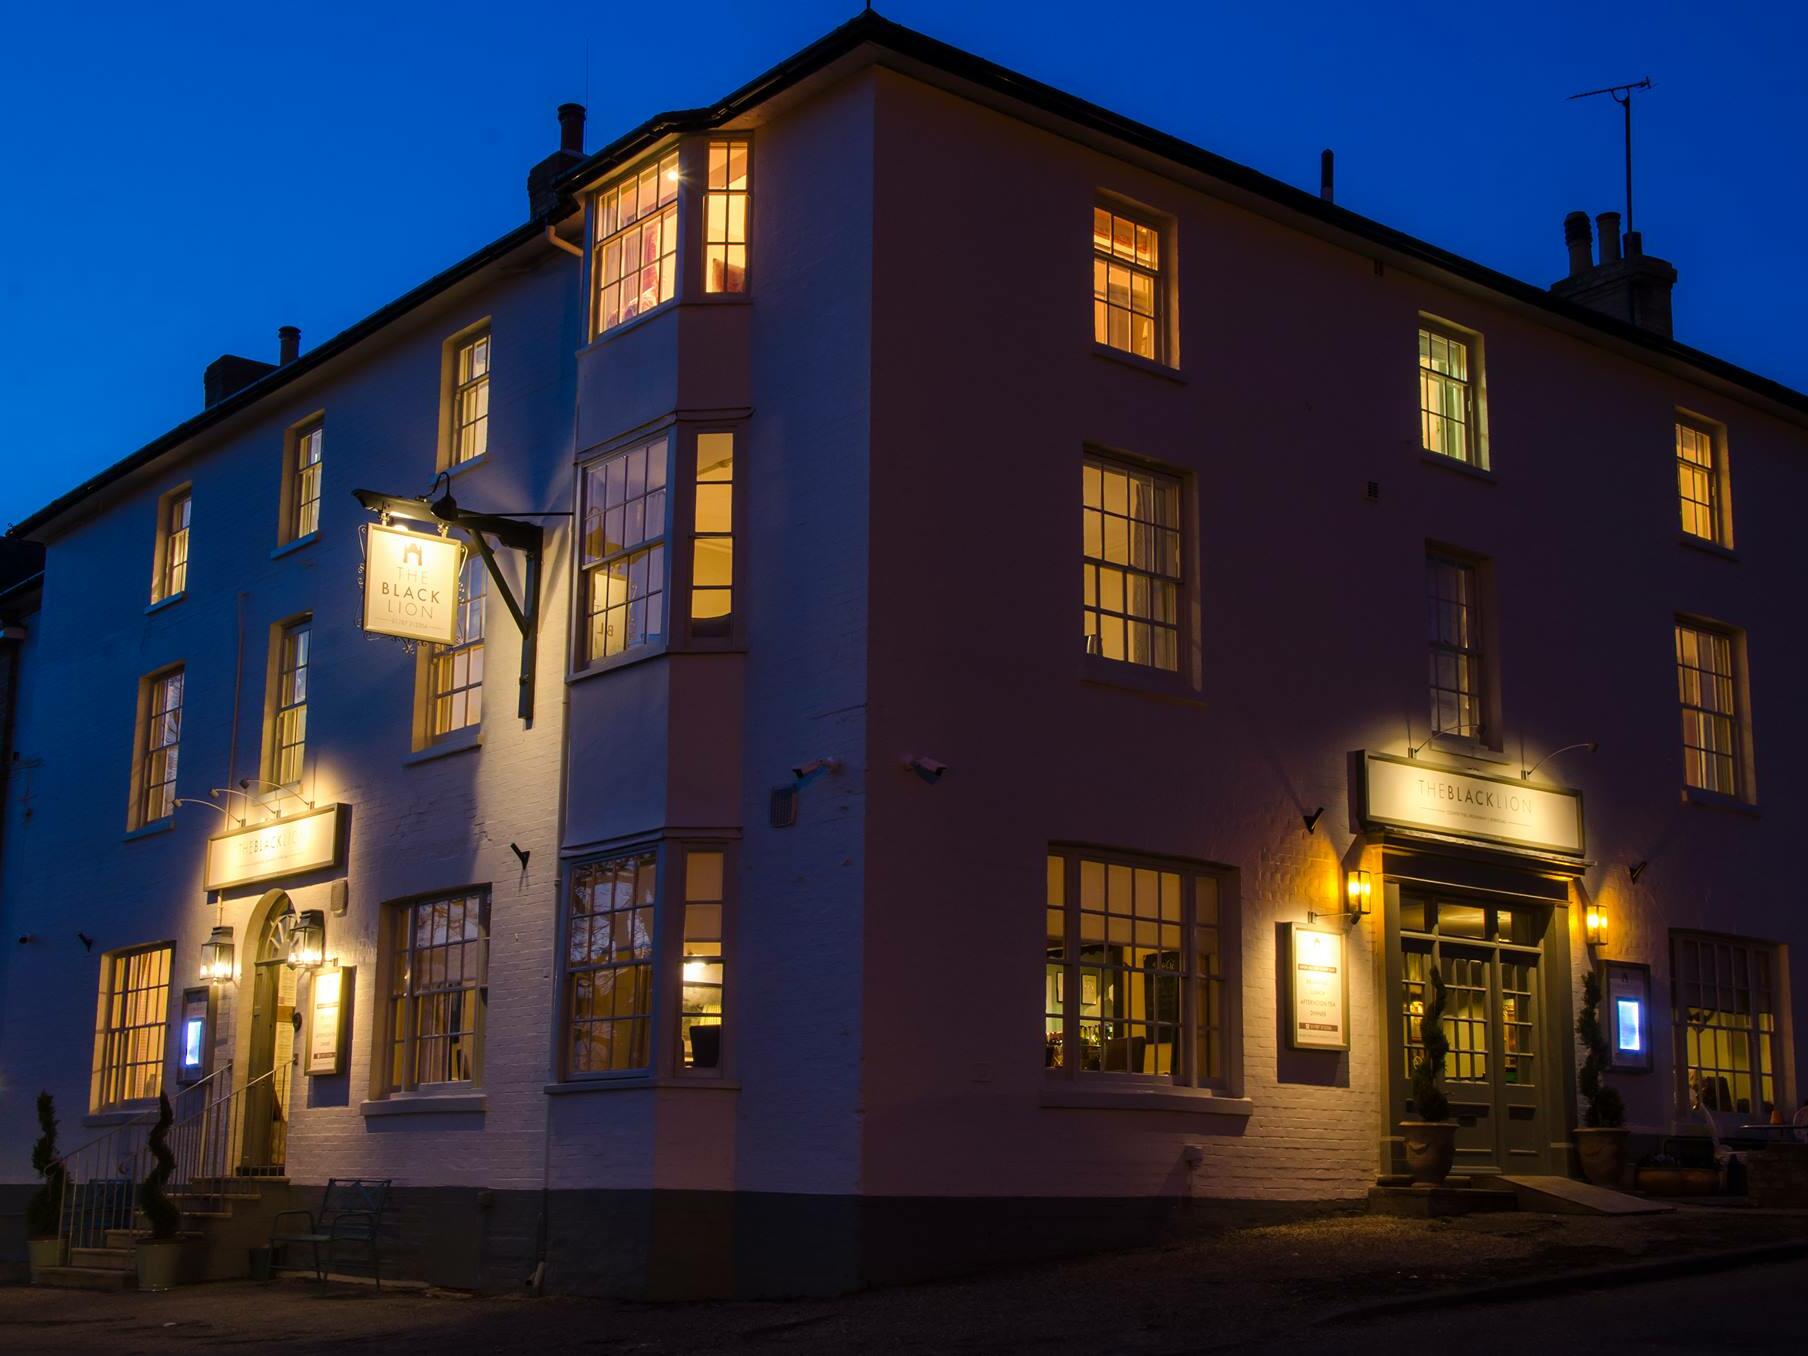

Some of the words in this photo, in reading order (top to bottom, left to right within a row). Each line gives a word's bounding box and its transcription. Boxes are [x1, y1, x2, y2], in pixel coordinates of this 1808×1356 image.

[397, 567, 429, 585] THE
[382, 582, 440, 604] BLACK
[387, 599, 434, 619] LION
